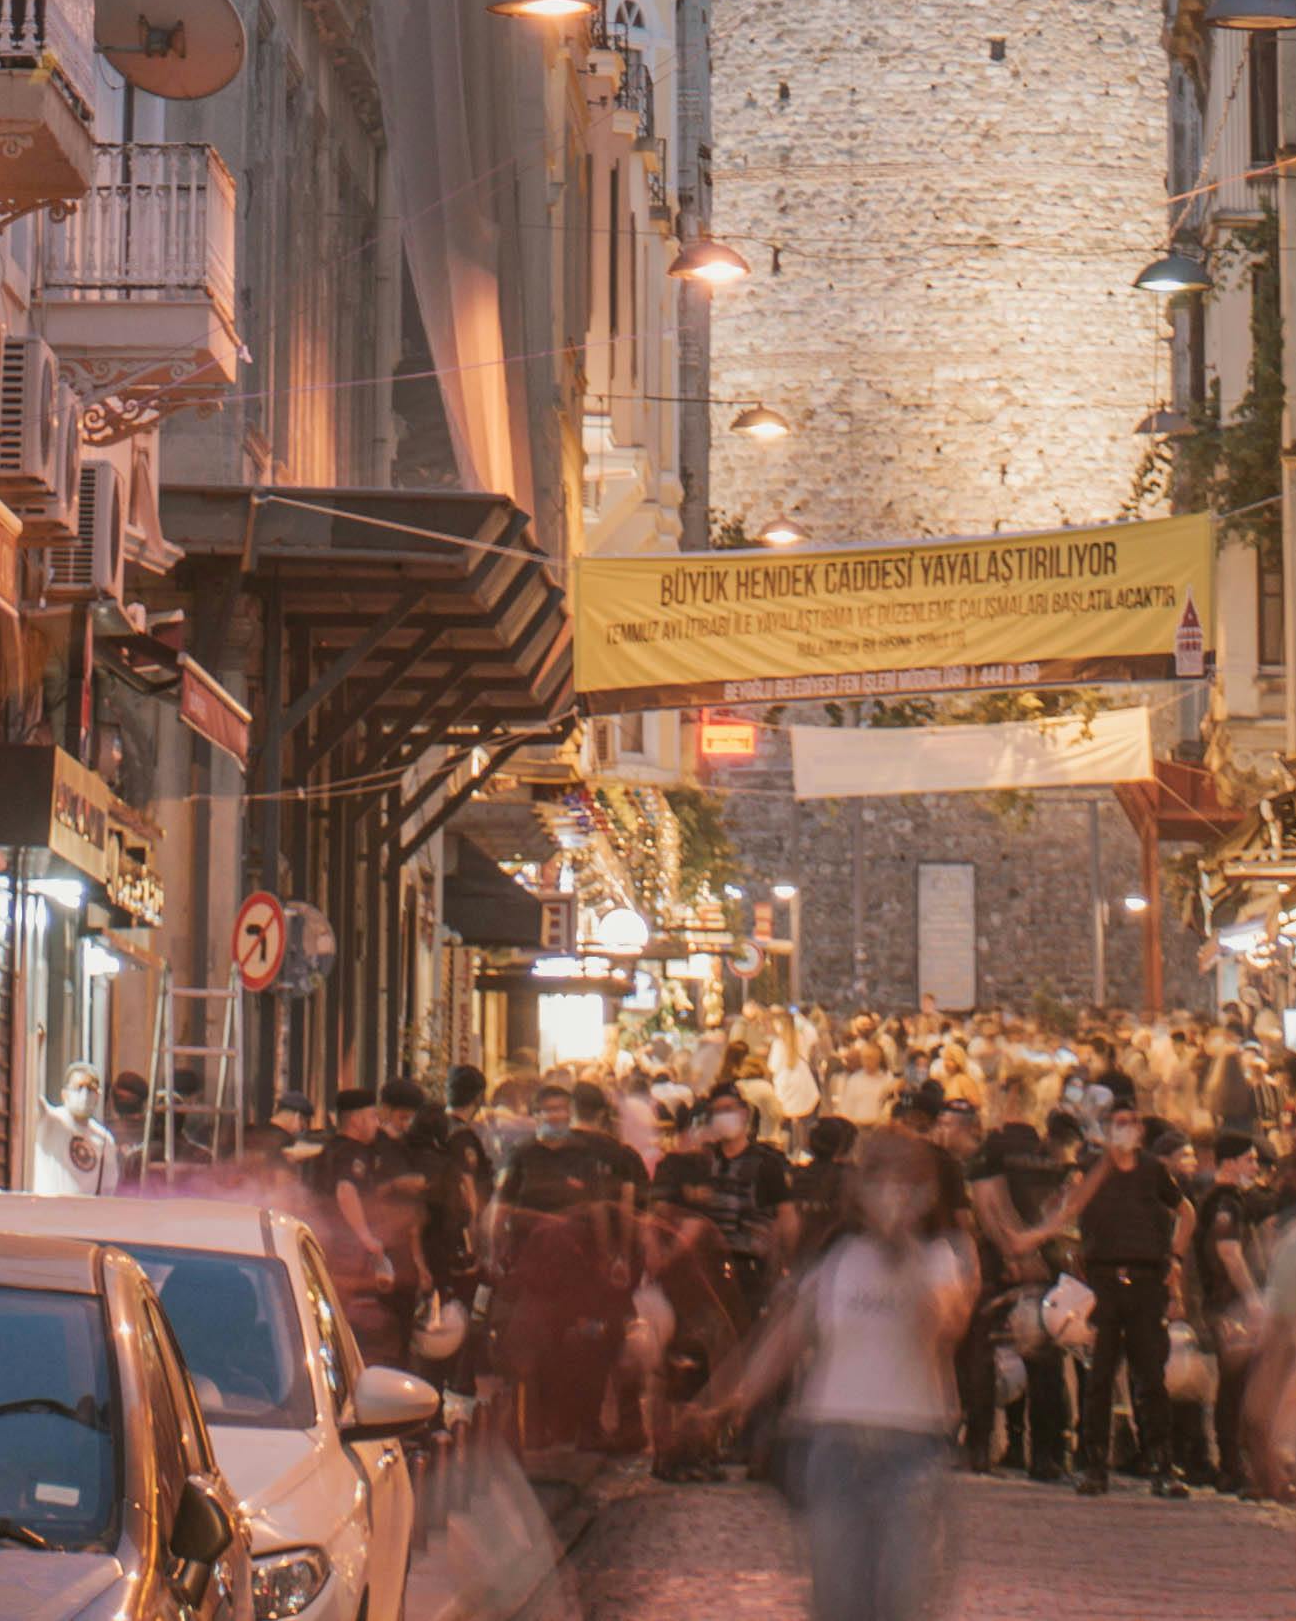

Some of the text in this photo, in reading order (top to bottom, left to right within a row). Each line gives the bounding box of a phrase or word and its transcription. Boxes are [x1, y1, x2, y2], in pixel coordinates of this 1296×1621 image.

[660, 541, 1118, 607] BÜYÜK HENDEK CADDESİ YAYALAŞTIRILIYOR
